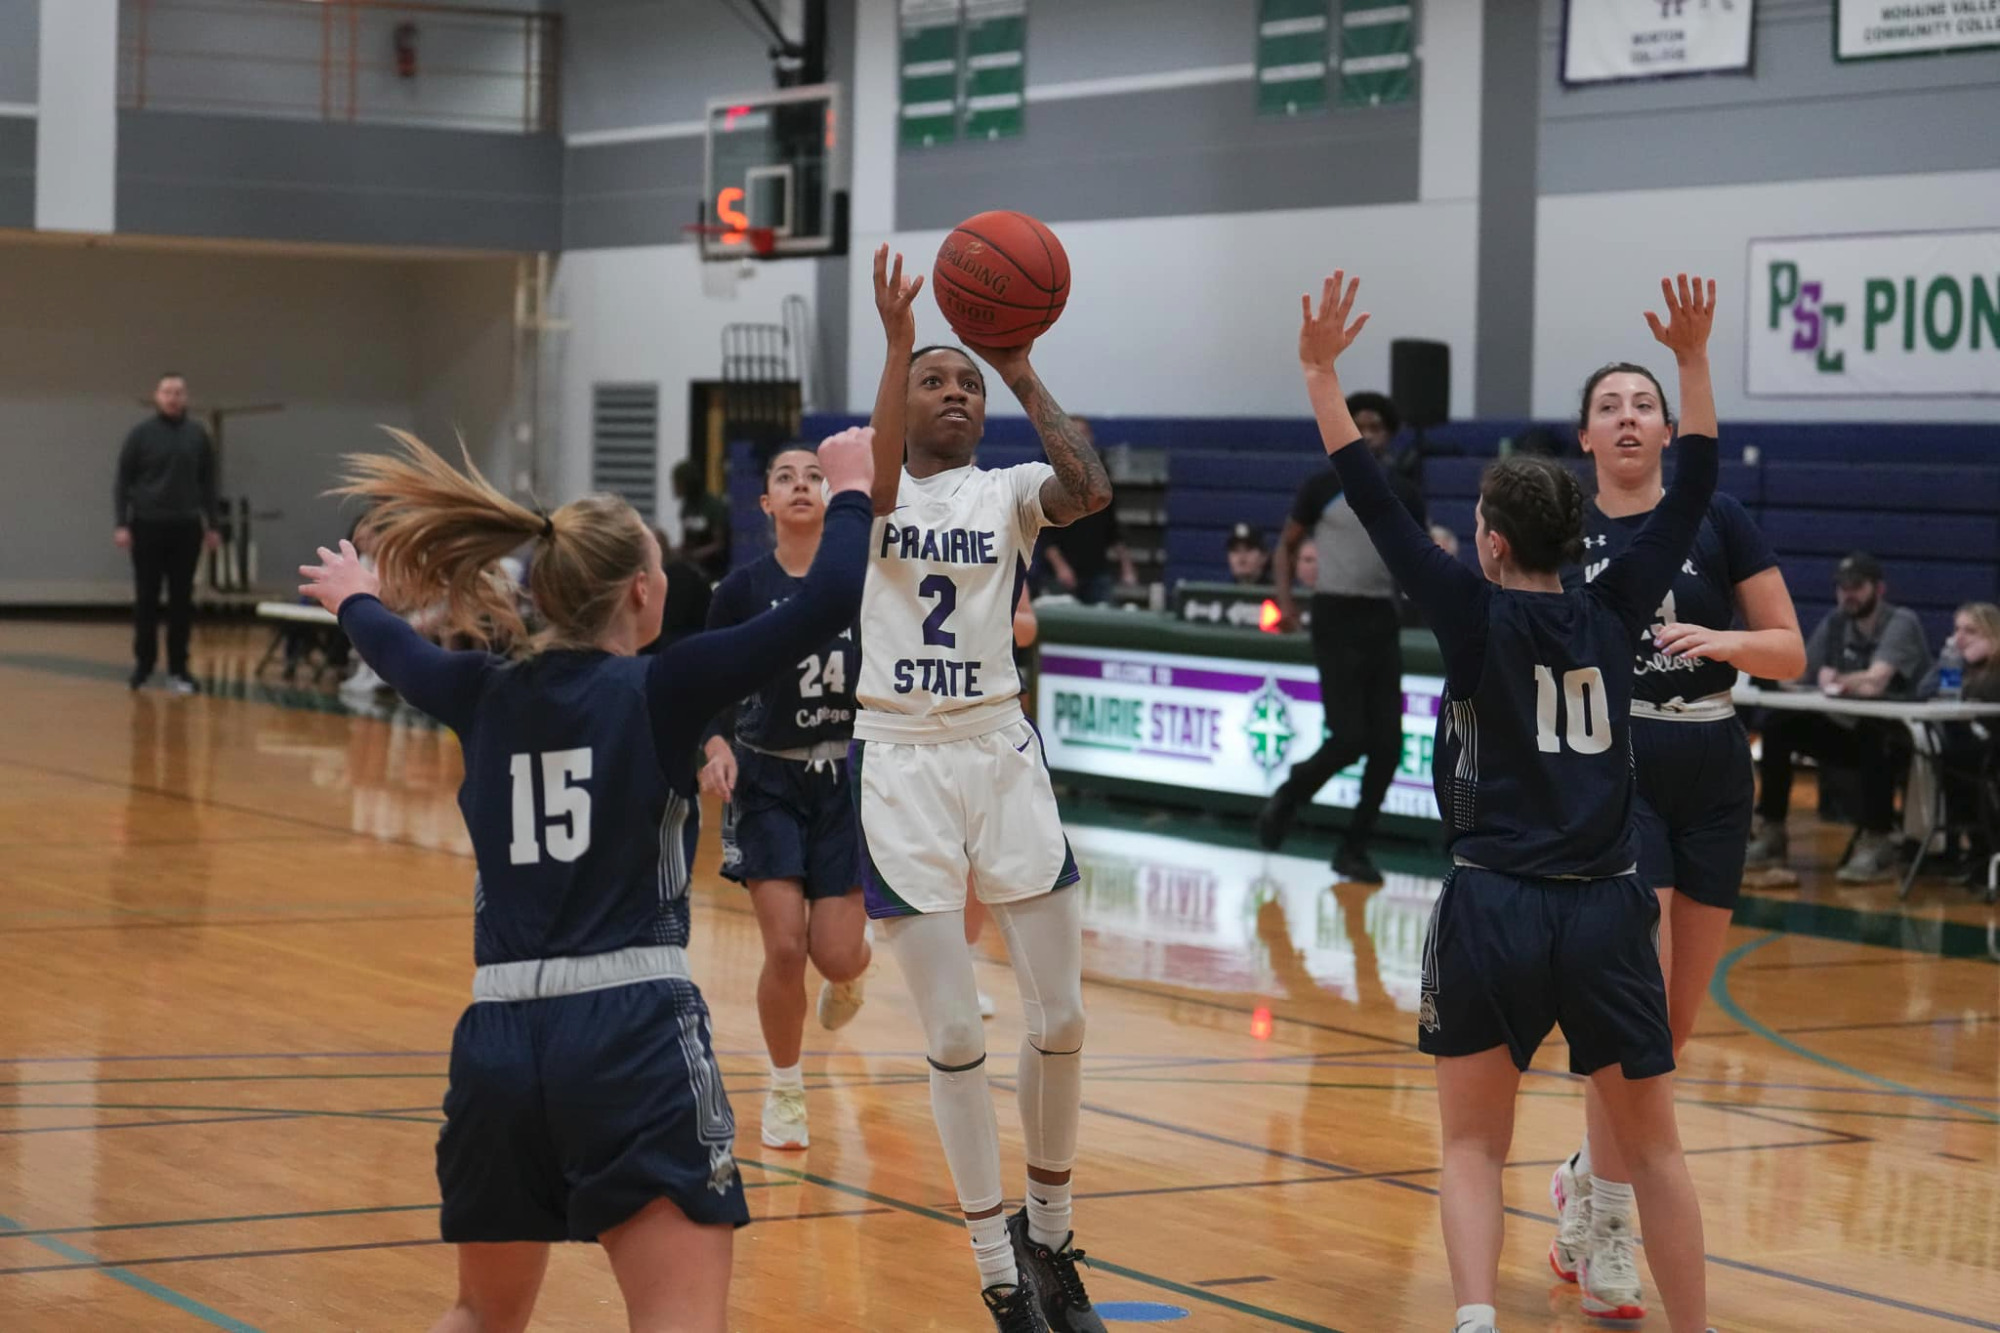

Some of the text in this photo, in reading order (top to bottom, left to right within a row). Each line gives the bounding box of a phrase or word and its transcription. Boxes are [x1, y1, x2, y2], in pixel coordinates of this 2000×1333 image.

[1863, 273, 2000, 353] PION
[881, 523, 998, 564] PRAIRIE
[918, 574, 957, 649] 2
[797, 650, 845, 698] 24
[894, 659, 984, 697] STATE
[796, 705, 851, 728] Colege
[1055, 691, 1221, 750] PRAIRIE STATE
[1535, 664, 1612, 754] 10
[510, 747, 592, 865] 15
